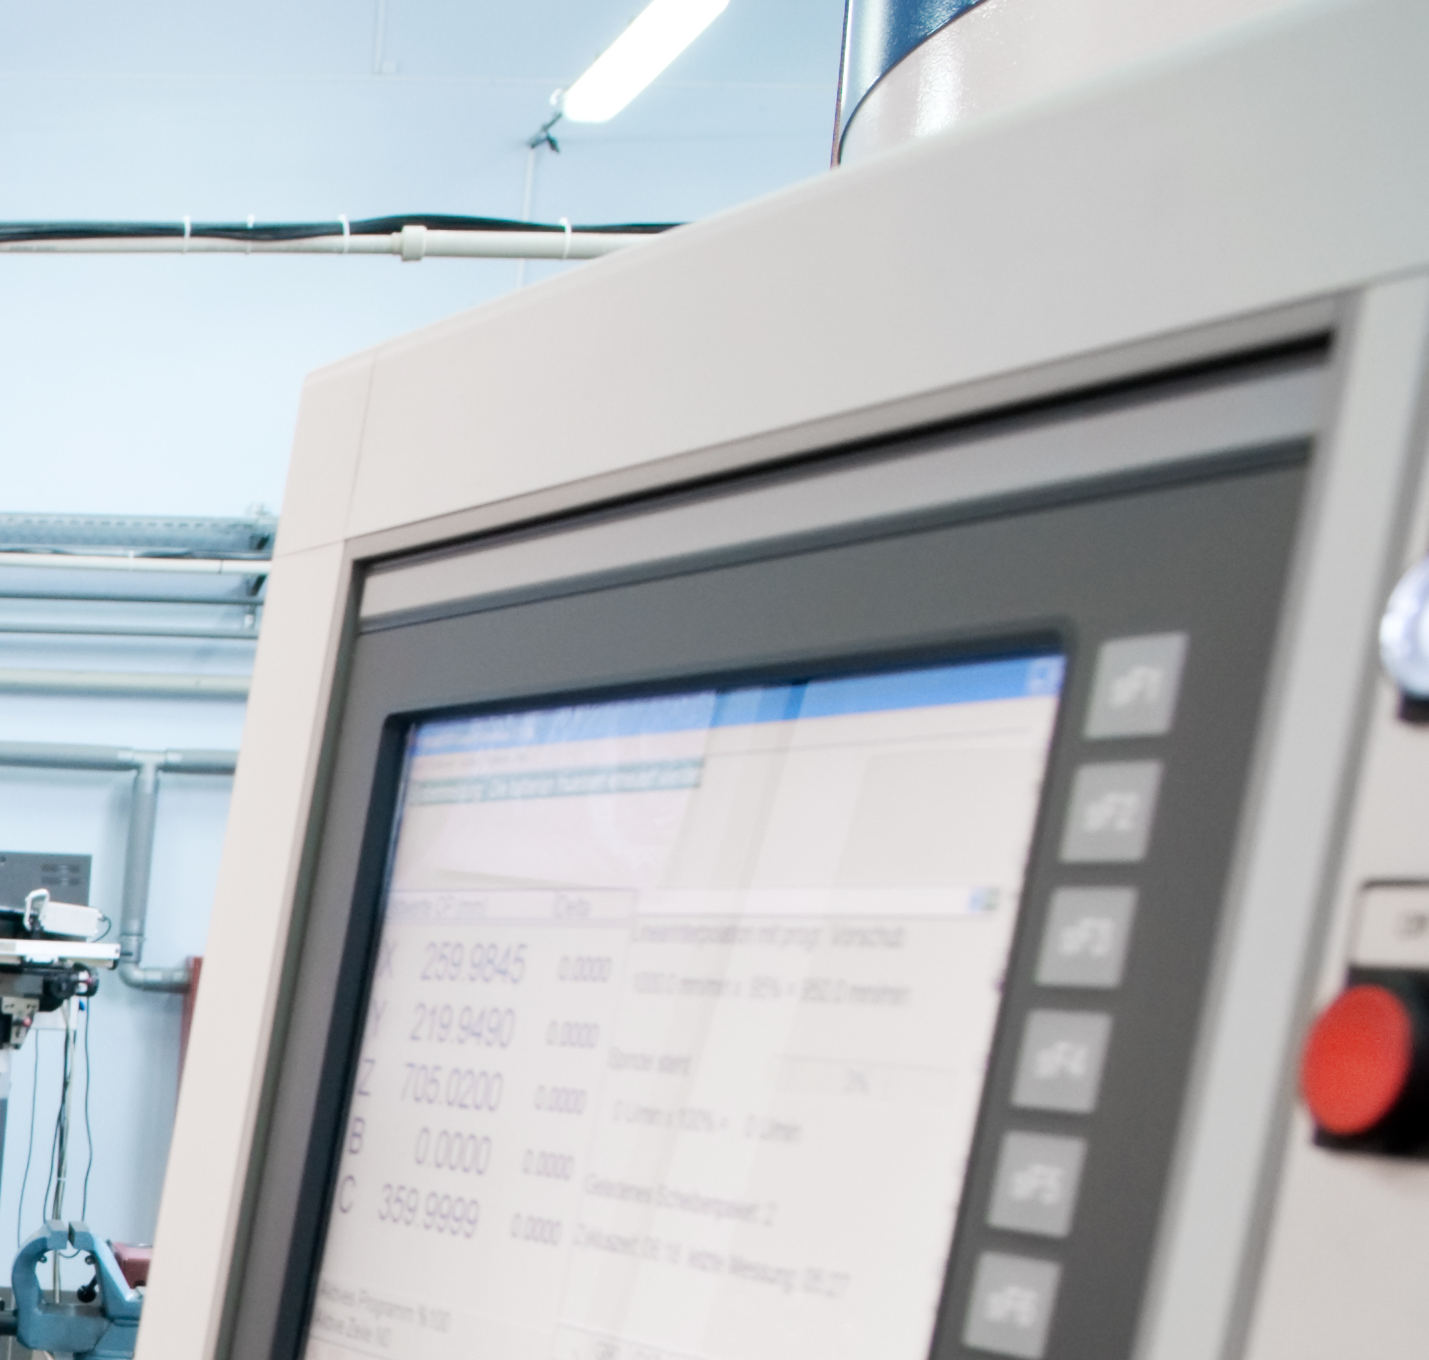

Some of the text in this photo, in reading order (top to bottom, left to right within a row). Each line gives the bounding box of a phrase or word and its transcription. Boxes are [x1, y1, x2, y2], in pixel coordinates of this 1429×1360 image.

[419, 943, 528, 986] 259.9845
[408, 1003, 517, 1050] 219.9490
[398, 1062, 505, 1114] 705.0200
[412, 1126, 494, 1177] 0.0000
[376, 1181, 482, 1240] 359.9999
